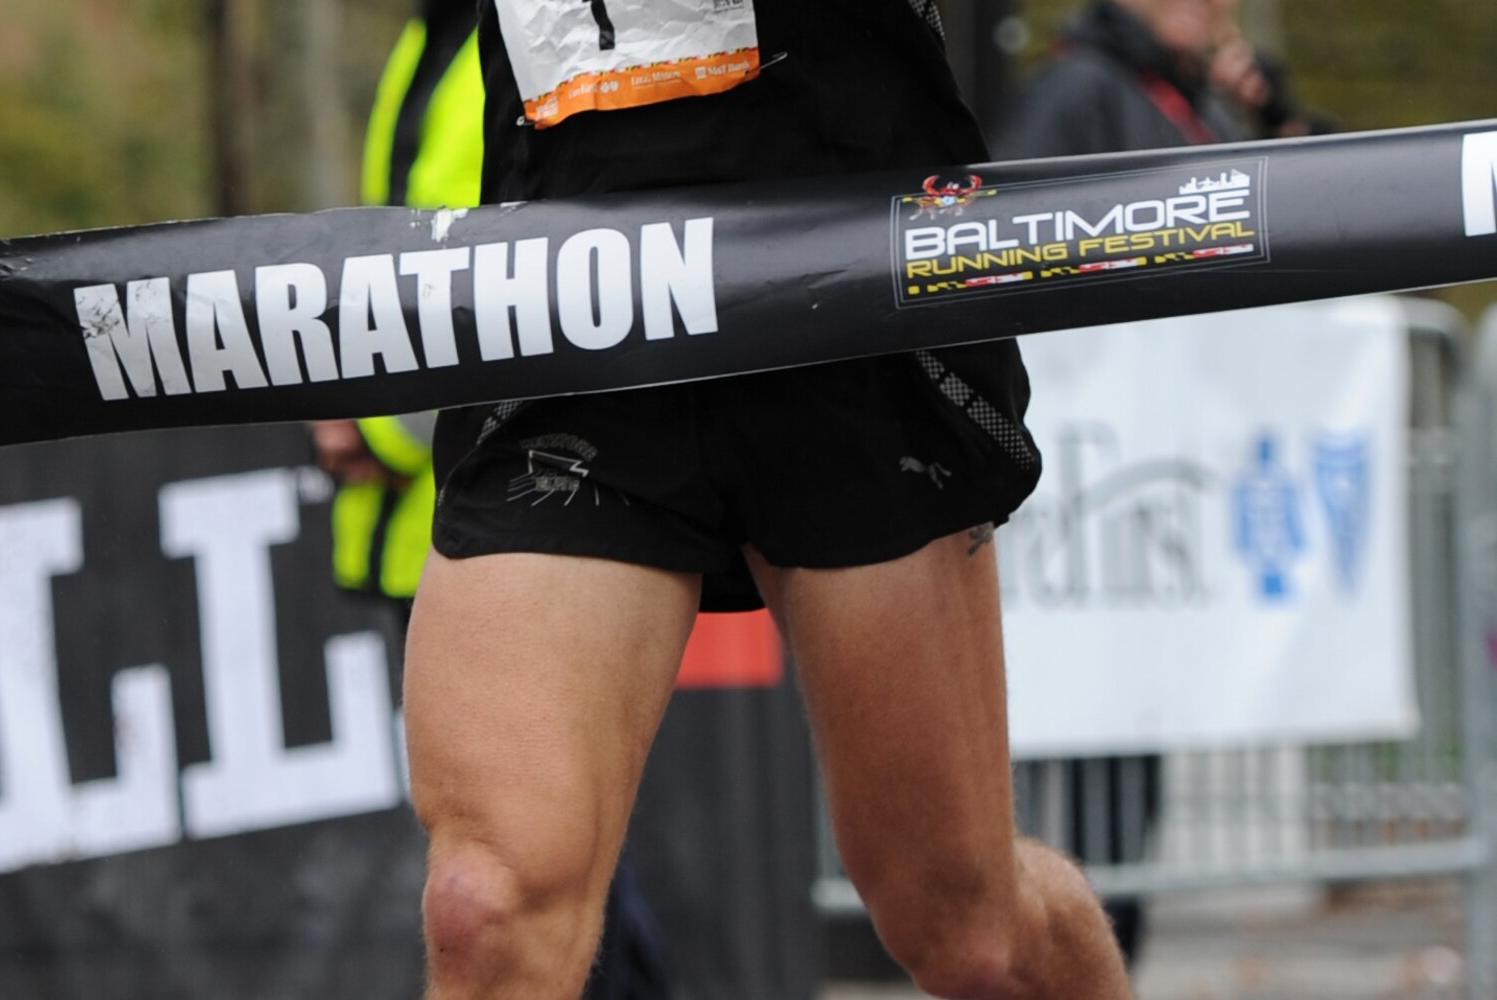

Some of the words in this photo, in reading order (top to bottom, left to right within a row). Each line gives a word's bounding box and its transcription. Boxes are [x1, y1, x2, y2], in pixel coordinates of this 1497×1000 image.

[905, 188, 1251, 261] BALTIMORE
[906, 242, 1069, 279] RUNNING
[1079, 221, 1256, 257] FESTIVAL
[74, 217, 718, 401] MARATHON
